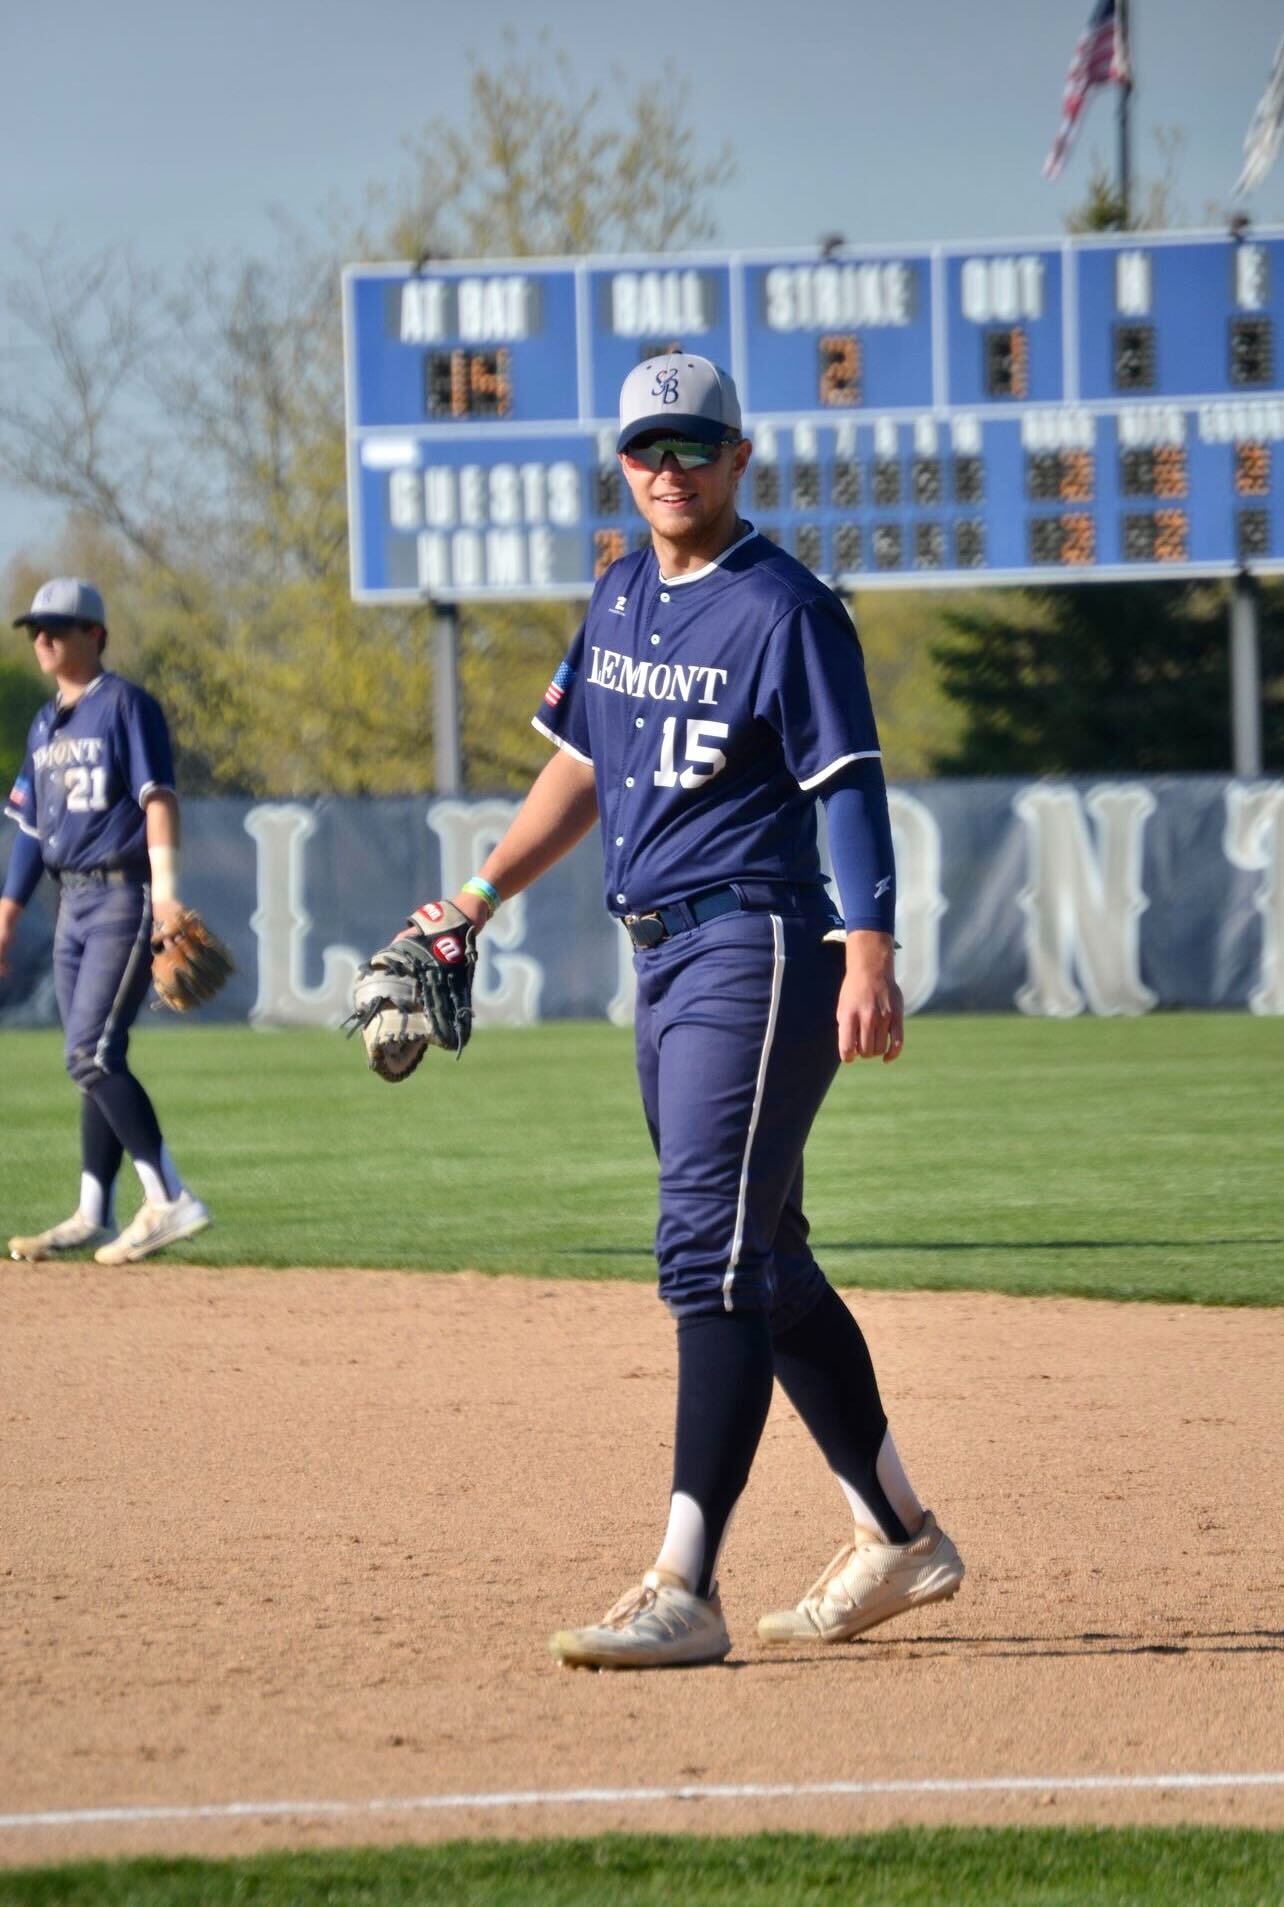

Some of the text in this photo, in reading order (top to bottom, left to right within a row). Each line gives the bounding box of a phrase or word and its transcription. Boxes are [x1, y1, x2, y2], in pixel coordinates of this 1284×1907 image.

[401, 275, 529, 343] AT BAT
[611, 269, 709, 338] BALL
[766, 261, 911, 332] STRIKE
[961, 255, 1045, 323] OUT
[450, 347, 512, 418] 15
[819, 334, 863, 407] 2
[389, 461, 579, 530] GUESTS
[416, 524, 552, 591] HOME
[587, 646, 728, 705] LEMONT
[653, 716, 729, 789] 15
[64, 766, 108, 813] 21
